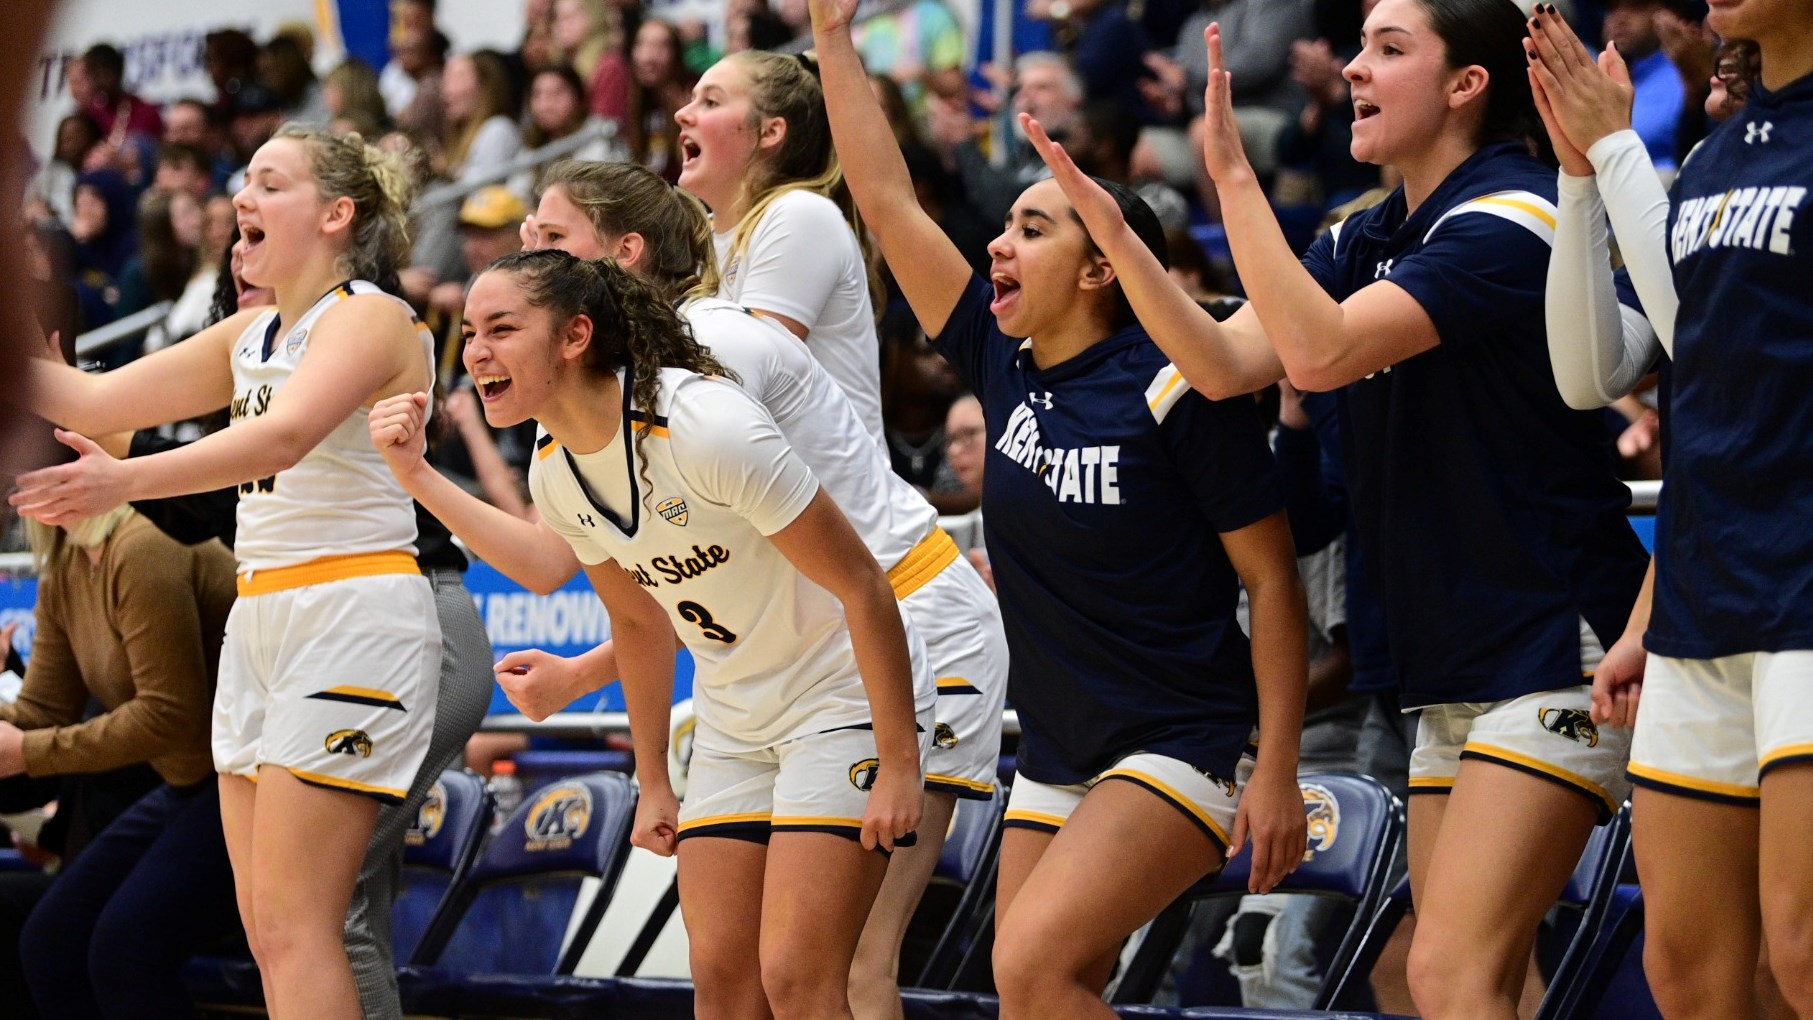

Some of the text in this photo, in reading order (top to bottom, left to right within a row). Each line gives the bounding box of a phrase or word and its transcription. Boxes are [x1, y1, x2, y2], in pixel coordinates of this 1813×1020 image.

[1708, 186, 1807, 255] STATE
[231, 389, 253, 419] ent
[661, 503, 689, 520] MAC
[651, 544, 731, 585] State
[486, 590, 612, 647] RENOW
[677, 600, 737, 644] 3
